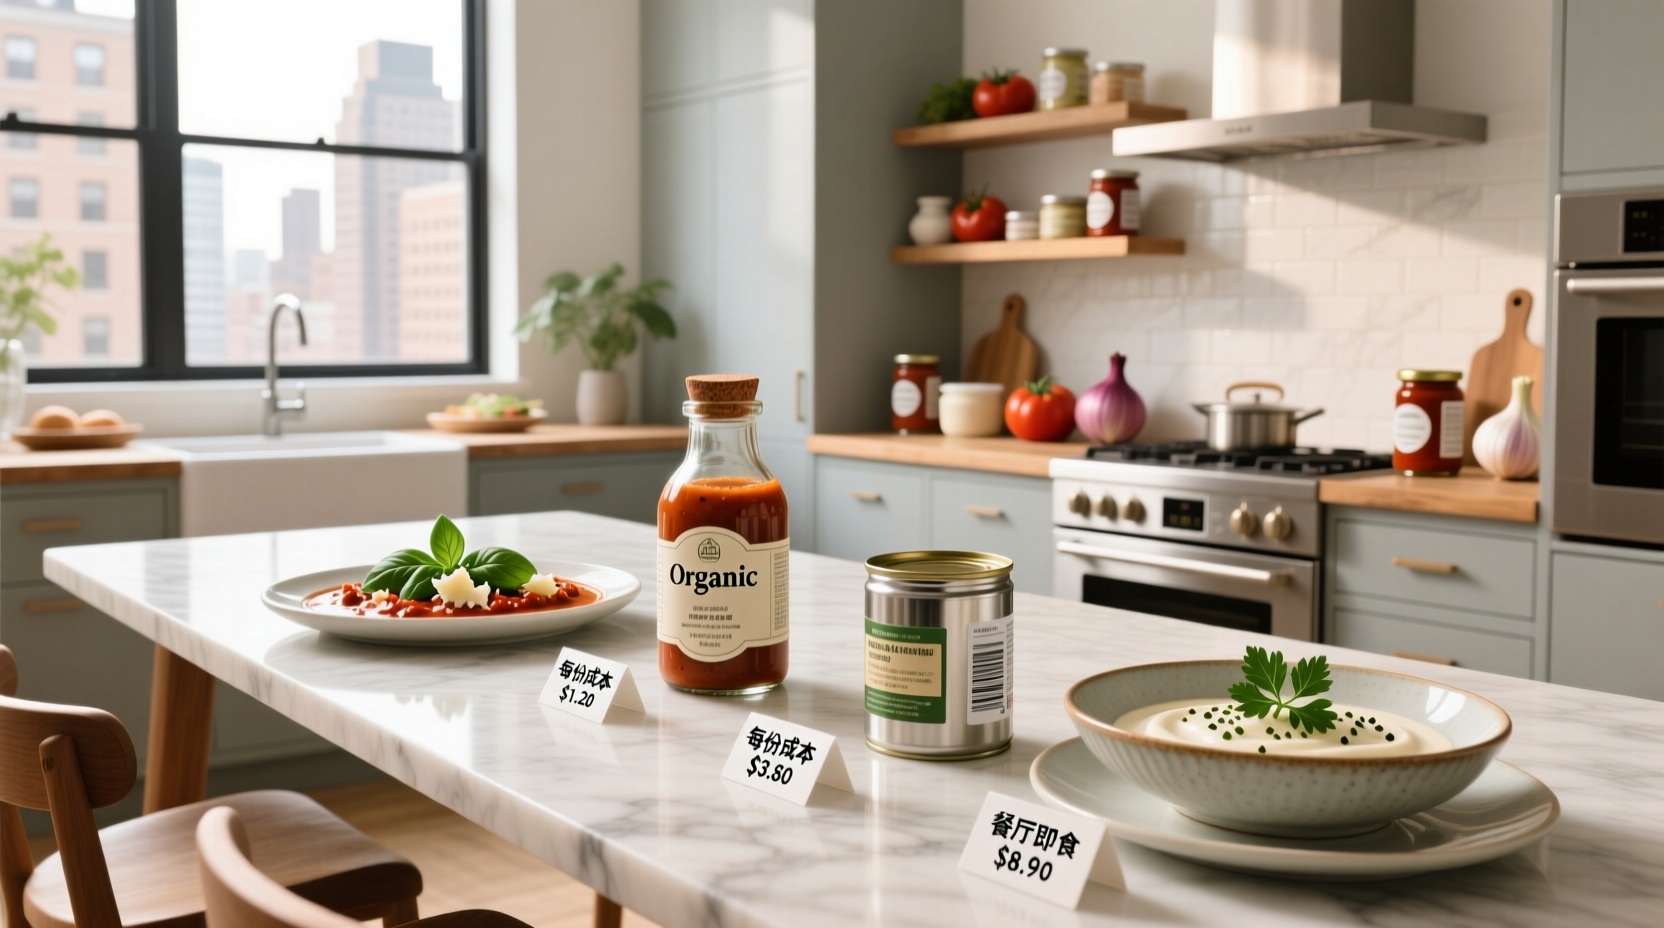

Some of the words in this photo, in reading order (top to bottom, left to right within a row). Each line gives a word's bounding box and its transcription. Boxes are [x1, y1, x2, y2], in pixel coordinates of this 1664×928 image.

[670, 563, 758, 595] Organic
[559, 659, 613, 691] 每份成本
[559, 684, 595, 707] $1.20
[747, 725, 816, 765] 每份成本
[747, 754, 793, 785] $3.80
[991, 811, 1080, 860] 餐厅即食
[994, 844, 1053, 882] $8.90
